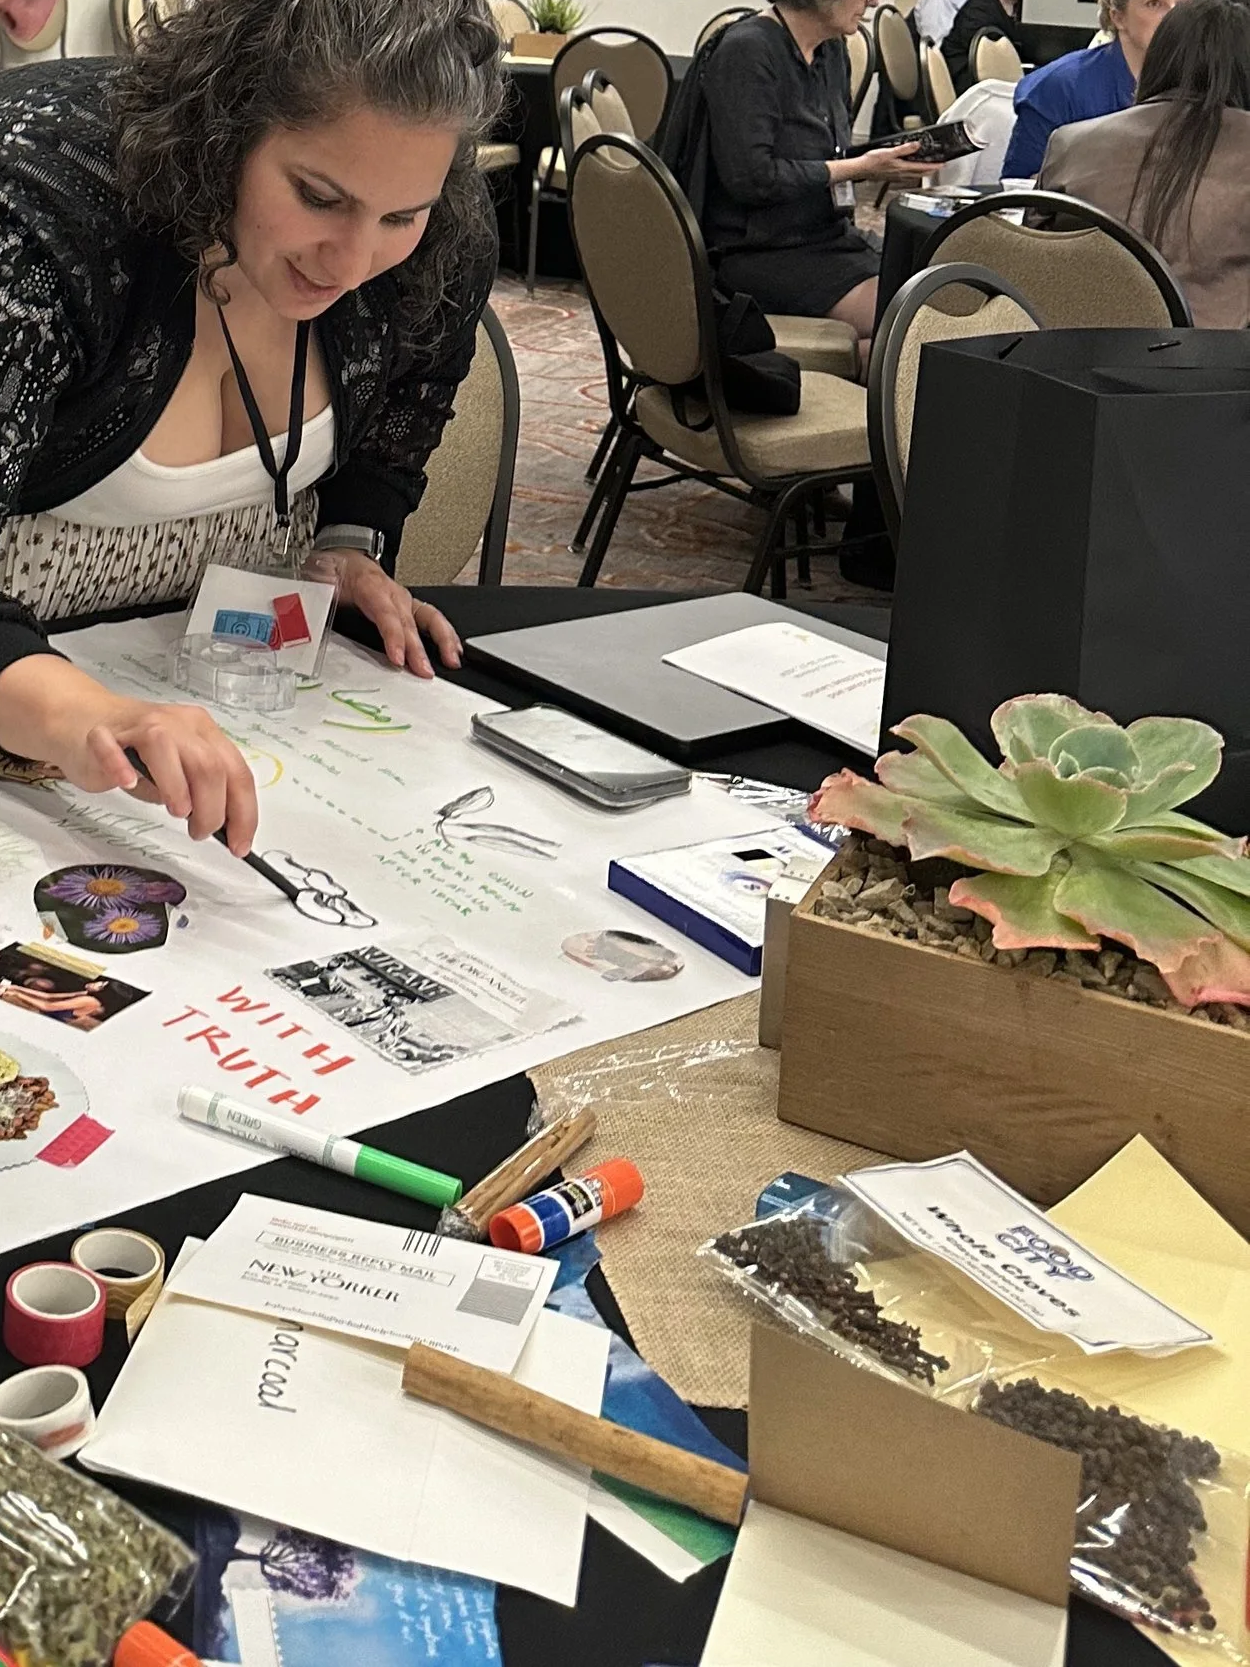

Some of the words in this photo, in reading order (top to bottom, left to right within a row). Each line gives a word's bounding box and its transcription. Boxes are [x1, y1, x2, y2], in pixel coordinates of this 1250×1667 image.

[50, 818, 190, 862] NATURE
[66, 798, 165, 836] WITH
[216, 985, 356, 1076] WITH
[162, 1004, 322, 1115] TRUTH
[226, 1108, 262, 1131] GREEN
[351, 1252, 397, 1273] REPLY
[400, 1265, 438, 1282] MAIL
[927, 1205, 997, 1260] Whole
[1000, 1263, 1082, 1319] Cloves
[996, 1233, 1077, 1281] CITY
[1007, 1225, 1095, 1282] FOOD
[249, 1259, 306, 1279] NEW
[310, 1272, 400, 1303] YORKER
